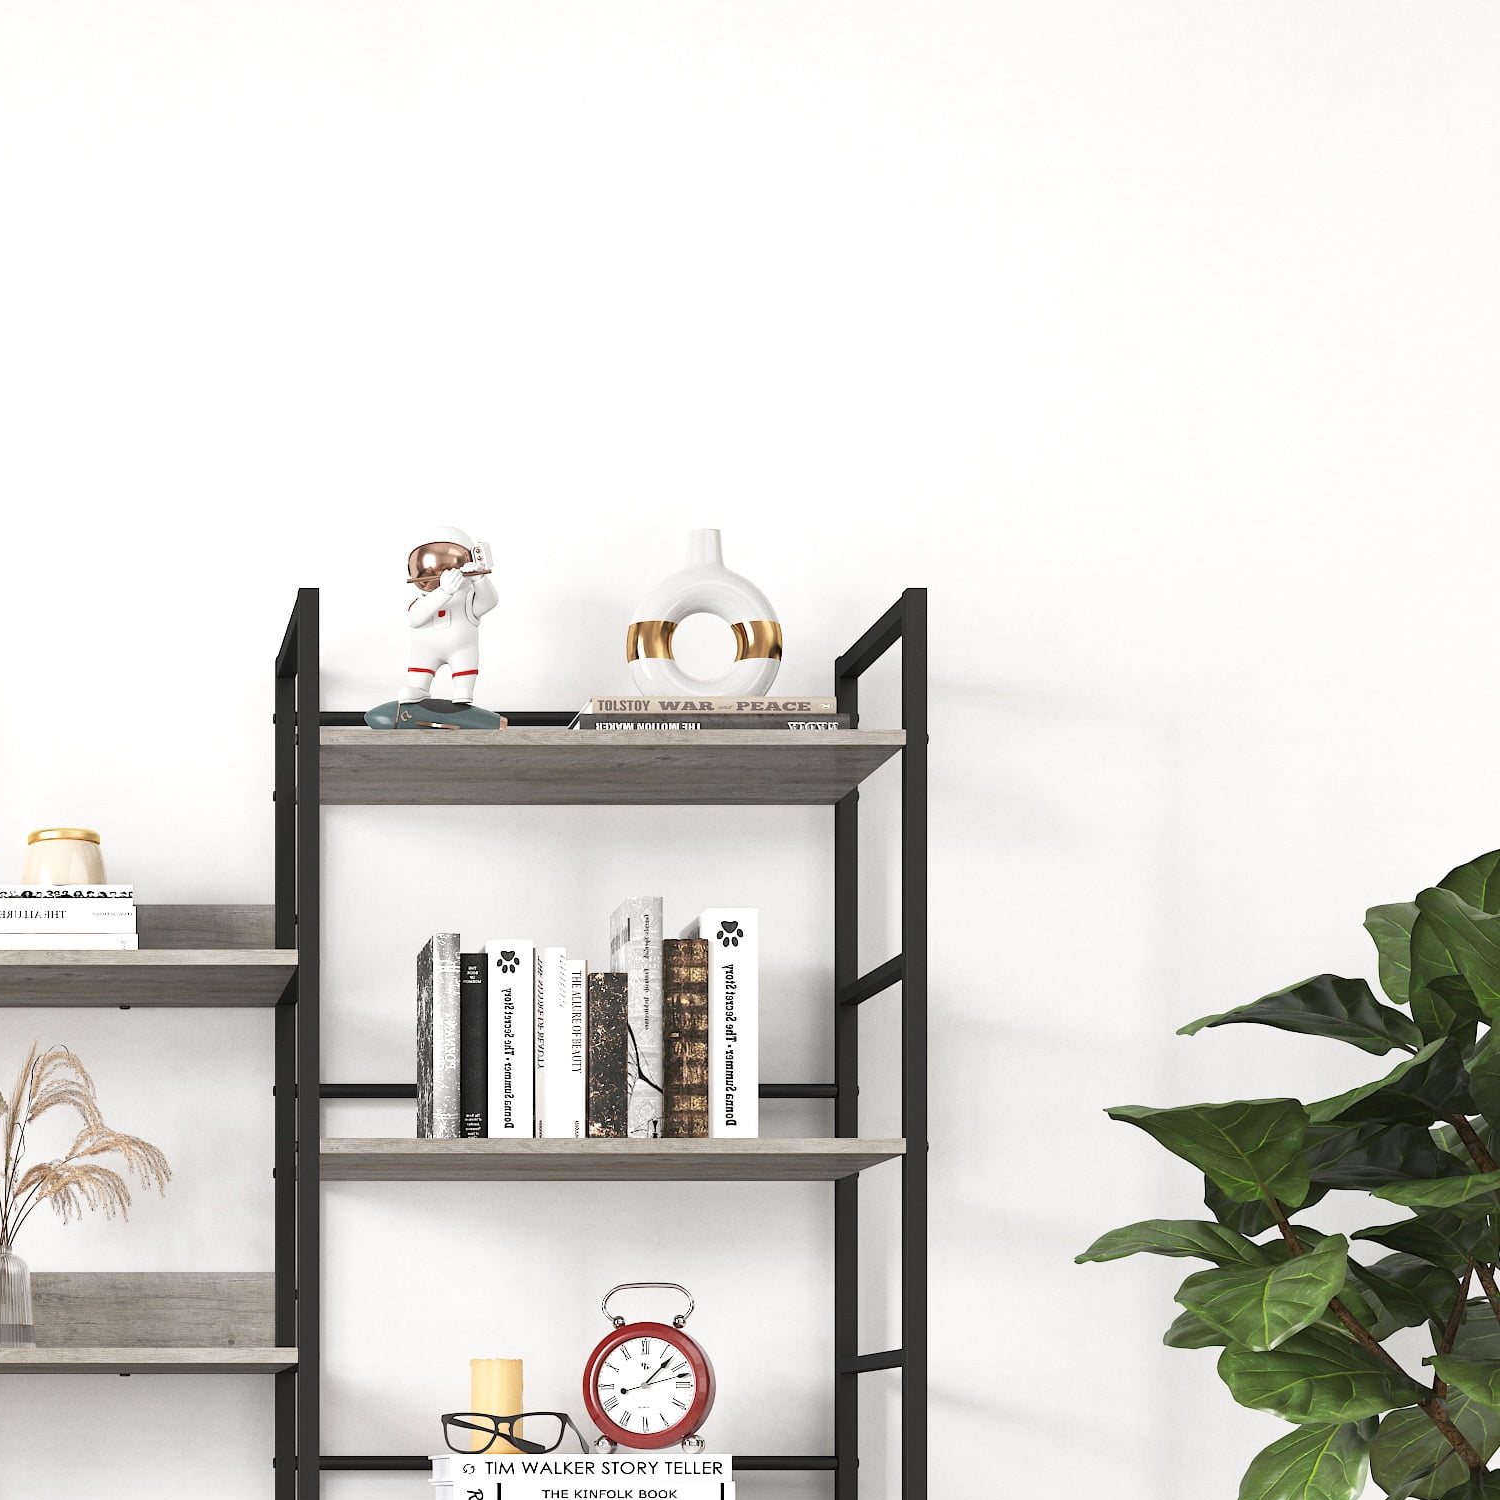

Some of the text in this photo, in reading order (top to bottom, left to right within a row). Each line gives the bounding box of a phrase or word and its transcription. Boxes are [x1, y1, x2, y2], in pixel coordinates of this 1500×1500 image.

[597, 699, 651, 712] TOLSTOY
[658, 701, 715, 711] WAR
[736, 701, 811, 711] PEACE
[571, 1038, 582, 1074] BEAUTY
[484, 1461, 723, 1475] TIM WALKER STORY TELLER
[541, 1489, 677, 1499] THE KINFOLK BOOK
